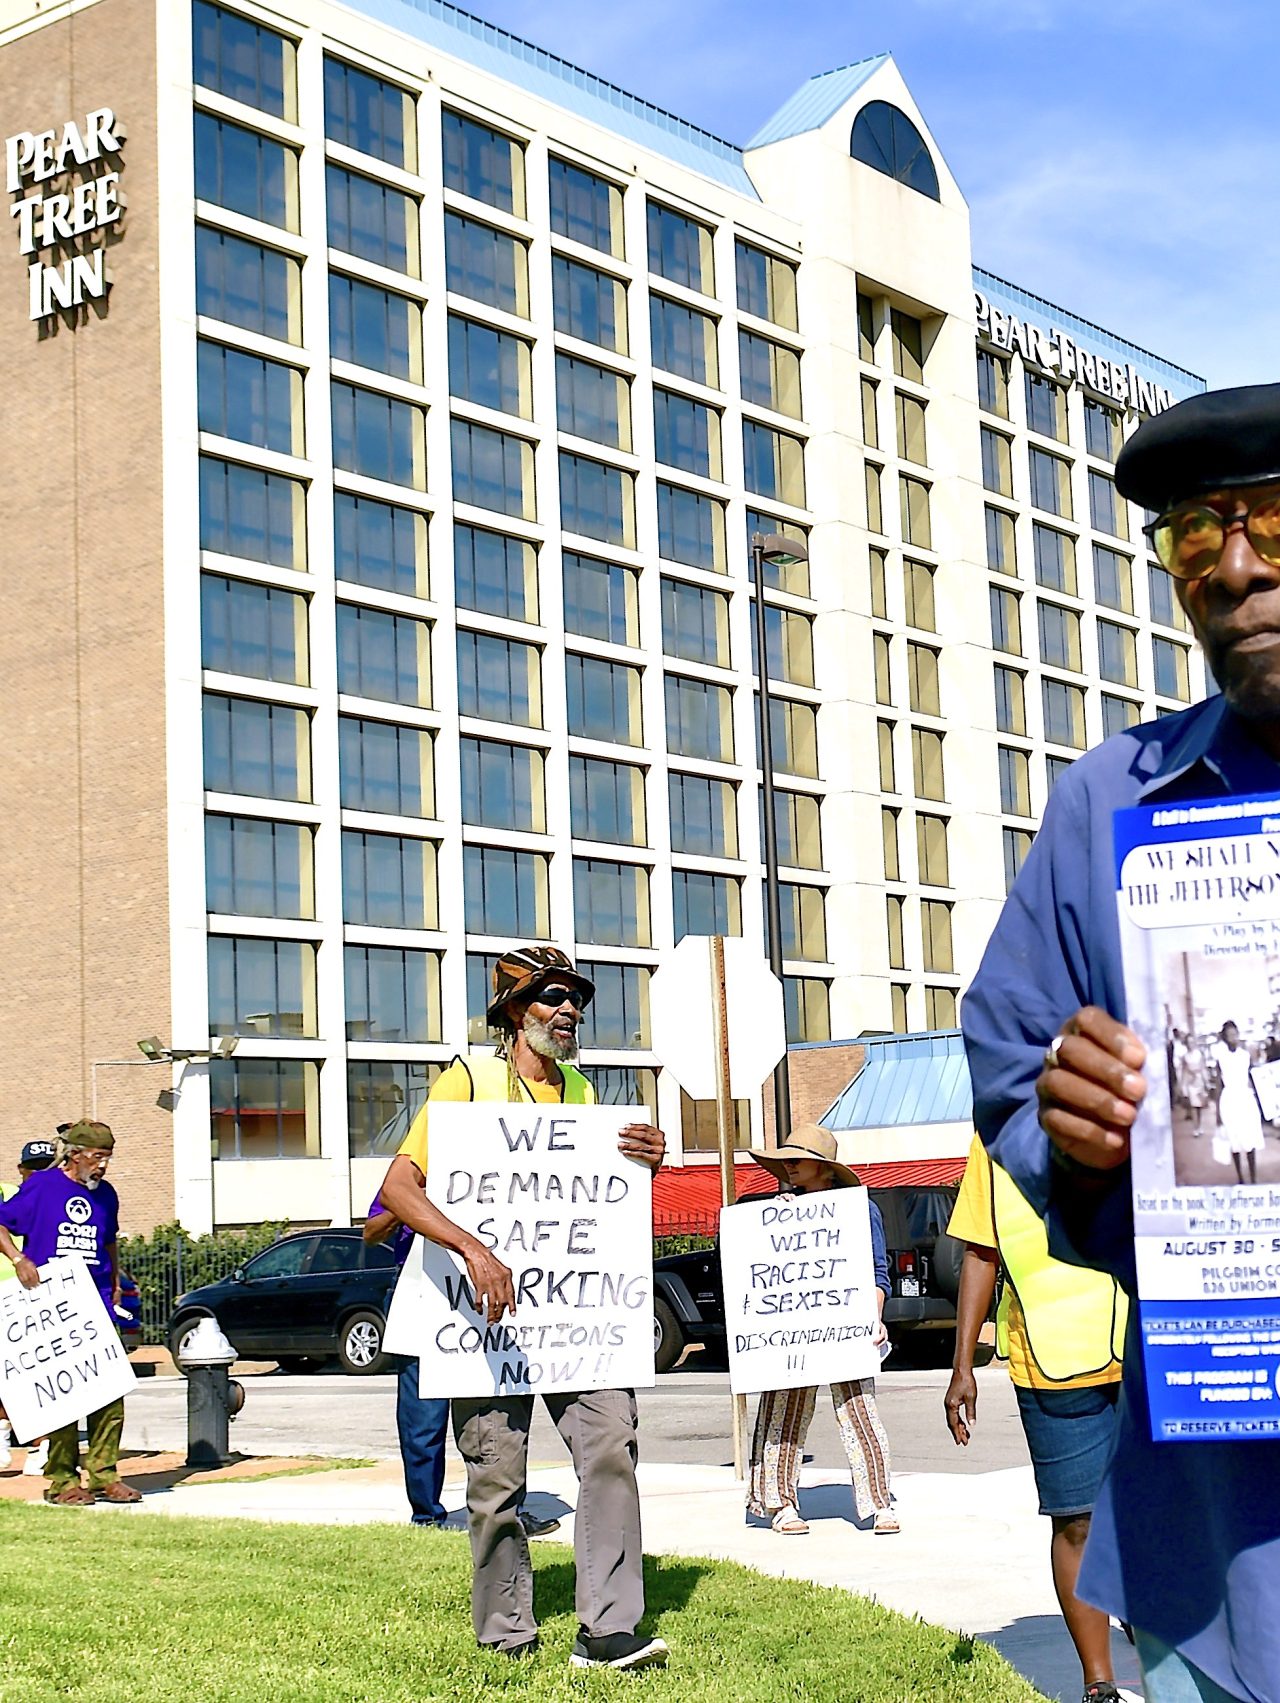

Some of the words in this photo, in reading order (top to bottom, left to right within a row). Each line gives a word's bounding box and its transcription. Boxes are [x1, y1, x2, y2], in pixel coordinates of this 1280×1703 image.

[6, 107, 122, 193] PEAR
[10, 172, 121, 255] TREE
[28, 248, 105, 320] INN
[974, 290, 1056, 370] PEAR
[1050, 328, 1129, 400] TREE
[1146, 850, 1173, 870] WE
[1186, 842, 1250, 867] SHALL
[1127, 883, 1158, 906] THE
[1252, 924, 1264, 935] by
[1255, 942, 1268, 954] by
[498, 1116, 577, 1152] WE
[446, 1170, 629, 1204] DEMAND
[762, 1203, 836, 1226] DOWN
[1189, 1216, 1226, 1232] Written
[1231, 1214, 1242, 1235] by
[57, 1236, 97, 1250] BUSH
[58, 1222, 97, 1238] CORI
[476, 1217, 598, 1255] SAFE
[771, 1229, 840, 1252] WITH
[1164, 1241, 1227, 1256] AUGUST
[1233, 1239, 1255, 1254] 30
[751, 1259, 847, 1289] RACIST
[1201, 1265, 1260, 1280] PILGRIM
[1229, 1279, 1277, 1293] UNION
[1, 1268, 76, 1317] EALTH
[445, 1267, 649, 1312] WRKING
[755, 1288, 859, 1315] SEXIST
[7, 1301, 78, 1343] CARE
[1145, 1321, 1180, 1331] TICKETS
[1183, 1321, 1203, 1331] CAN
[1206, 1320, 1218, 1330] BE
[1221, 1318, 1280, 1331] PURCHASED
[5, 1320, 98, 1380] ACCESS
[435, 1322, 627, 1354] CONDITIONS
[735, 1321, 875, 1353] DISCRIMINATION
[1164, 1422, 1177, 1433] TO
[1181, 1421, 1231, 1433] RESERVE
[1236, 1420, 1279, 1432] TICKETS
